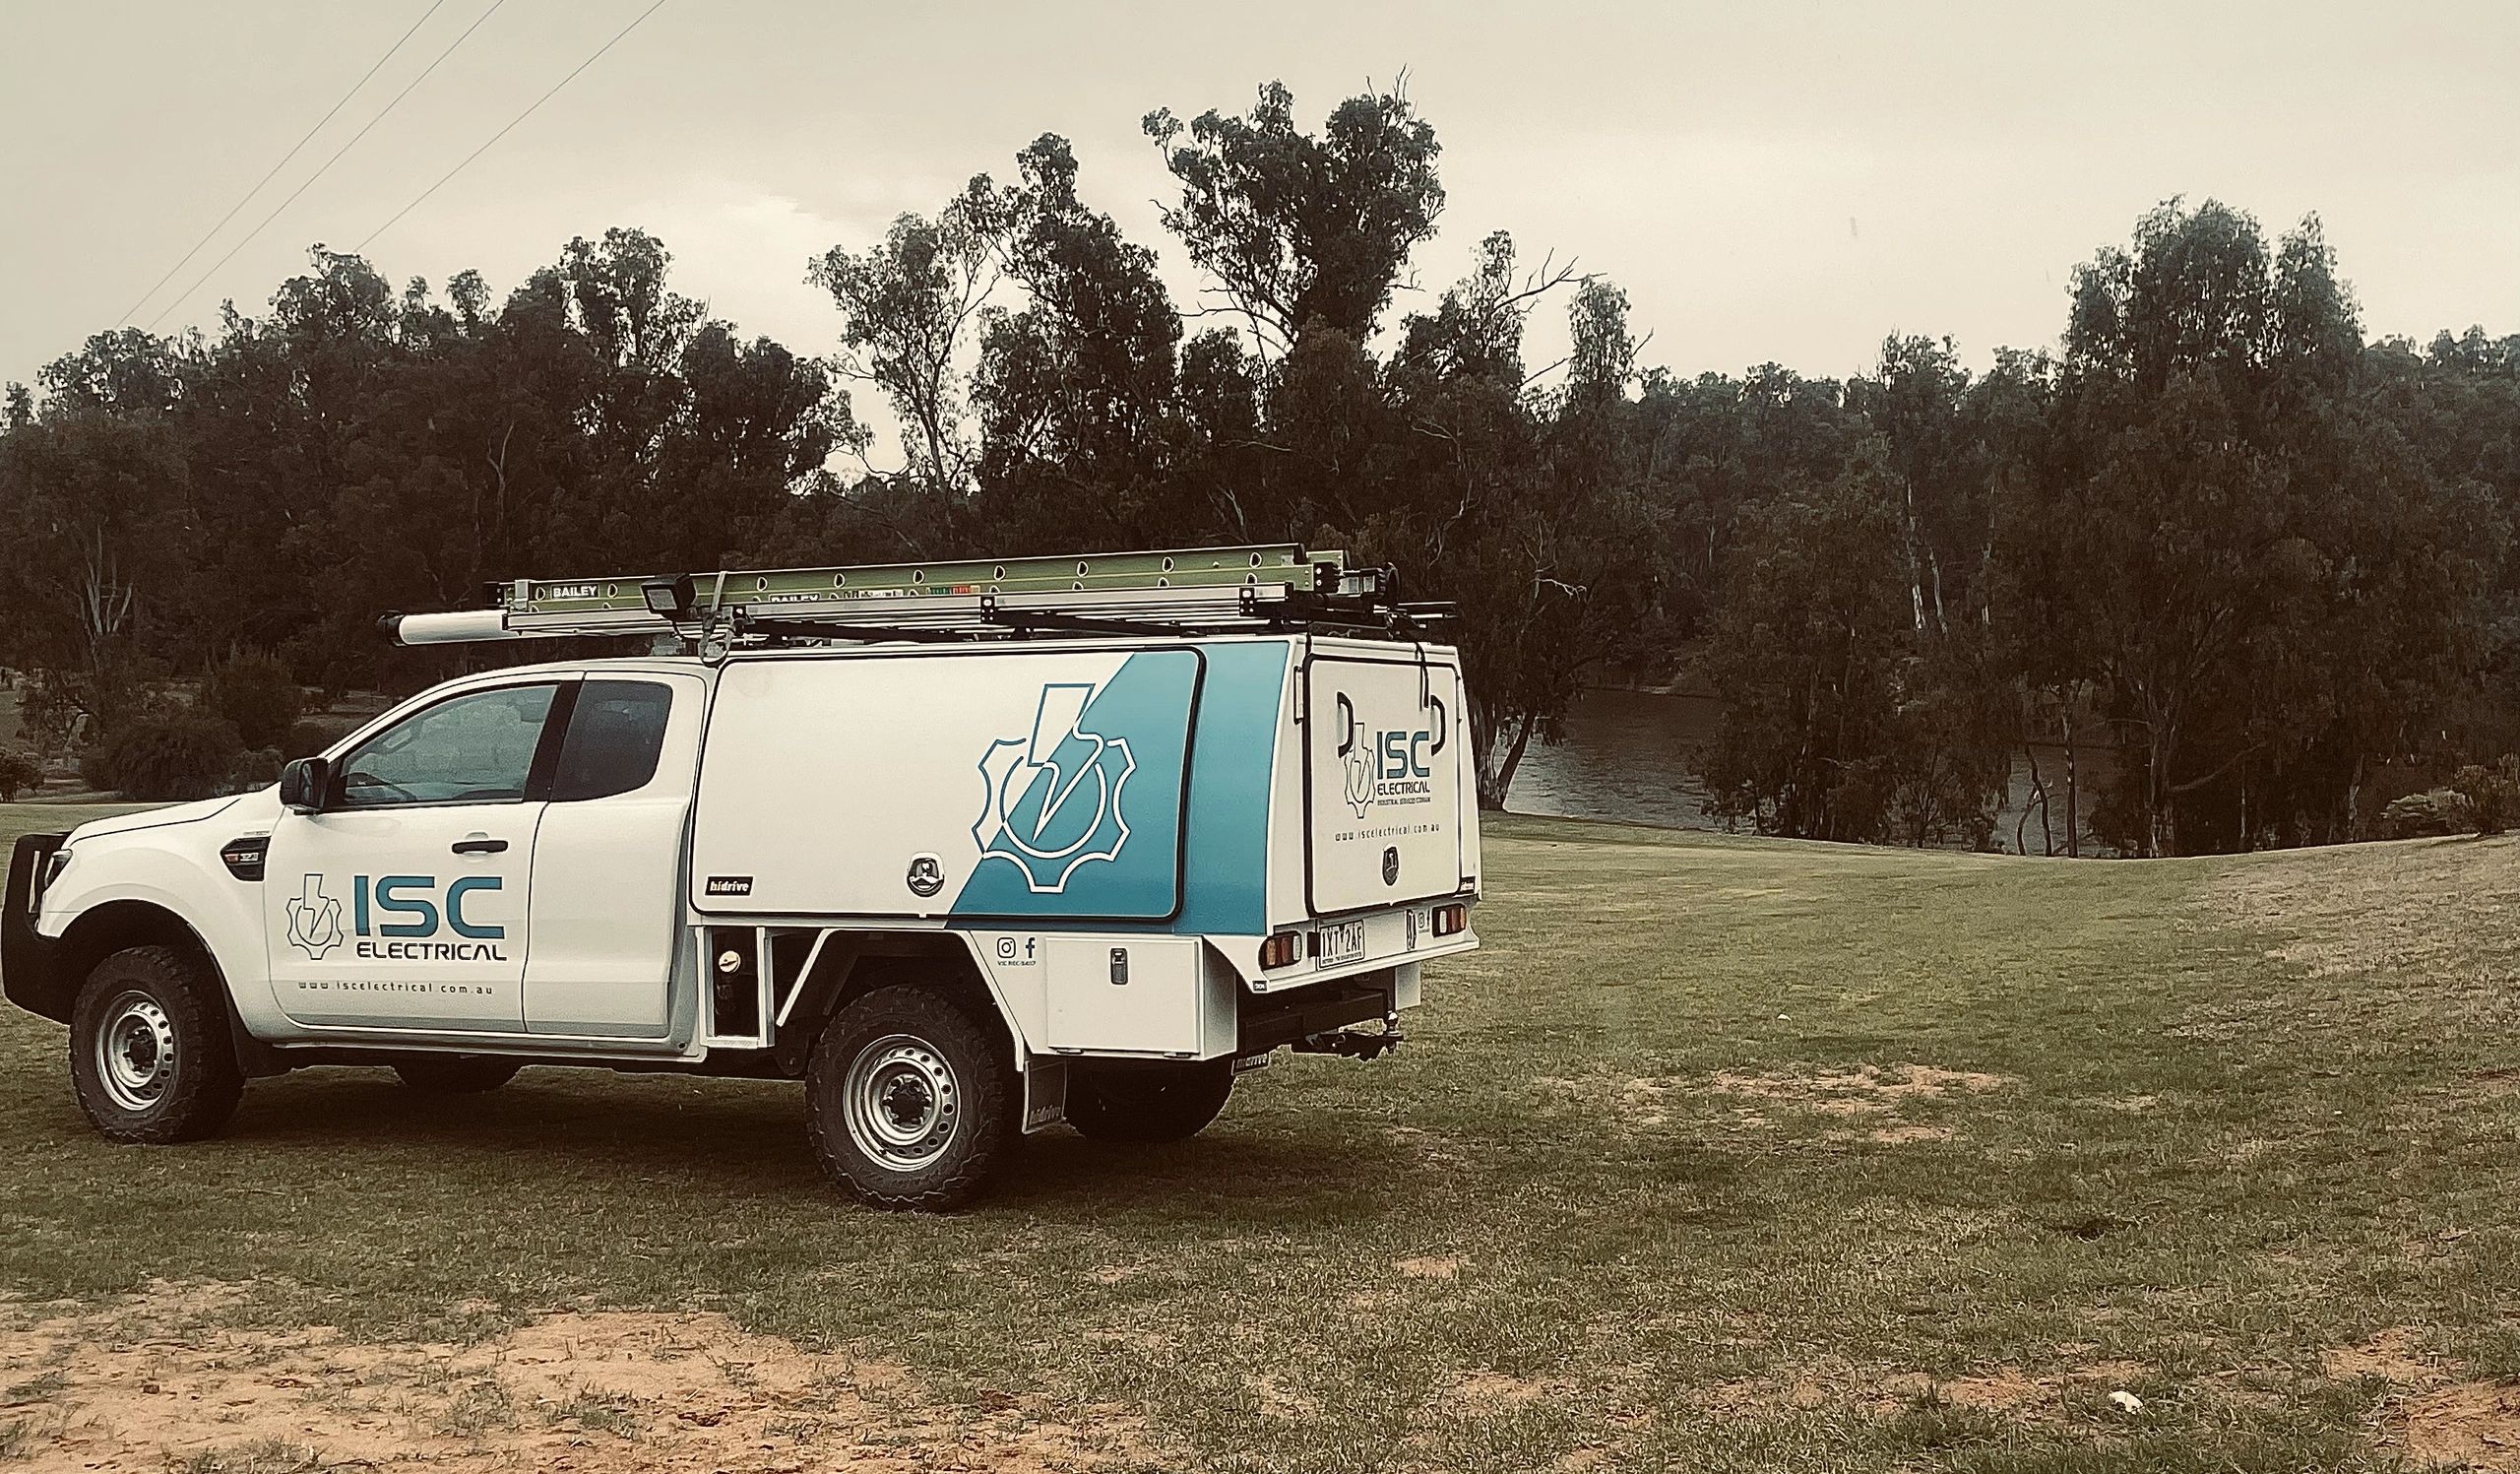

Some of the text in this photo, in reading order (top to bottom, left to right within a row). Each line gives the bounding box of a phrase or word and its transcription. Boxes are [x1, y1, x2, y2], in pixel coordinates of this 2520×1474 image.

[553, 585, 597, 598] BAILEY
[1376, 731, 1430, 779] ISC
[1377, 781, 1430, 796] ELECTRICAL
[710, 880, 749, 892] hidrive
[354, 875, 505, 939] ISC
[356, 941, 507, 961] ELECTRICAL
[297, 981, 493, 995] www.iscelectrical.com.au
